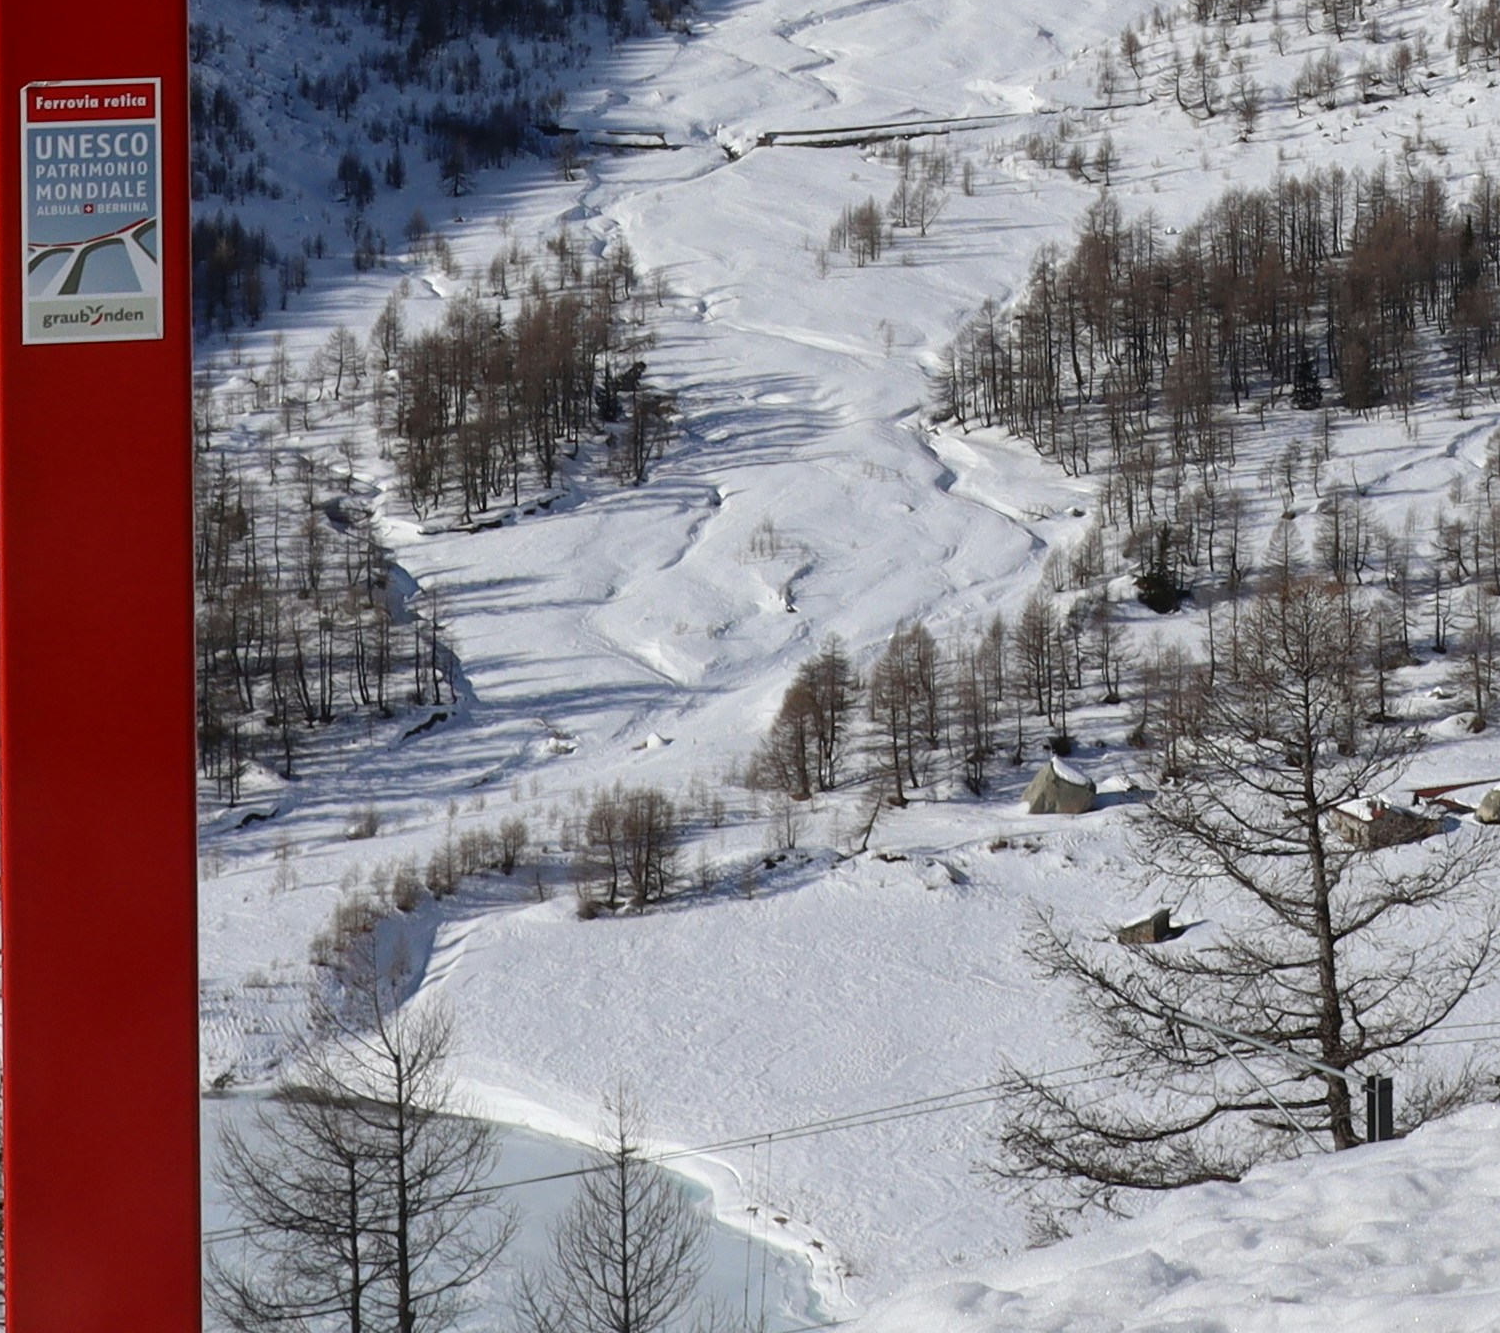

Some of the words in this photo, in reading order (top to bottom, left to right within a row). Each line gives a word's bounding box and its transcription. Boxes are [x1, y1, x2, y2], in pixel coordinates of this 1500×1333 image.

[36, 94, 99, 110] Ferrovia
[104, 92, 148, 108] retica
[35, 131, 149, 160] UNESCO
[36, 160, 148, 179] PATRIMONIO
[36, 180, 148, 201] MONDIALE
[36, 205, 80, 217] ALBULA
[97, 202, 149, 214] BERNINA
